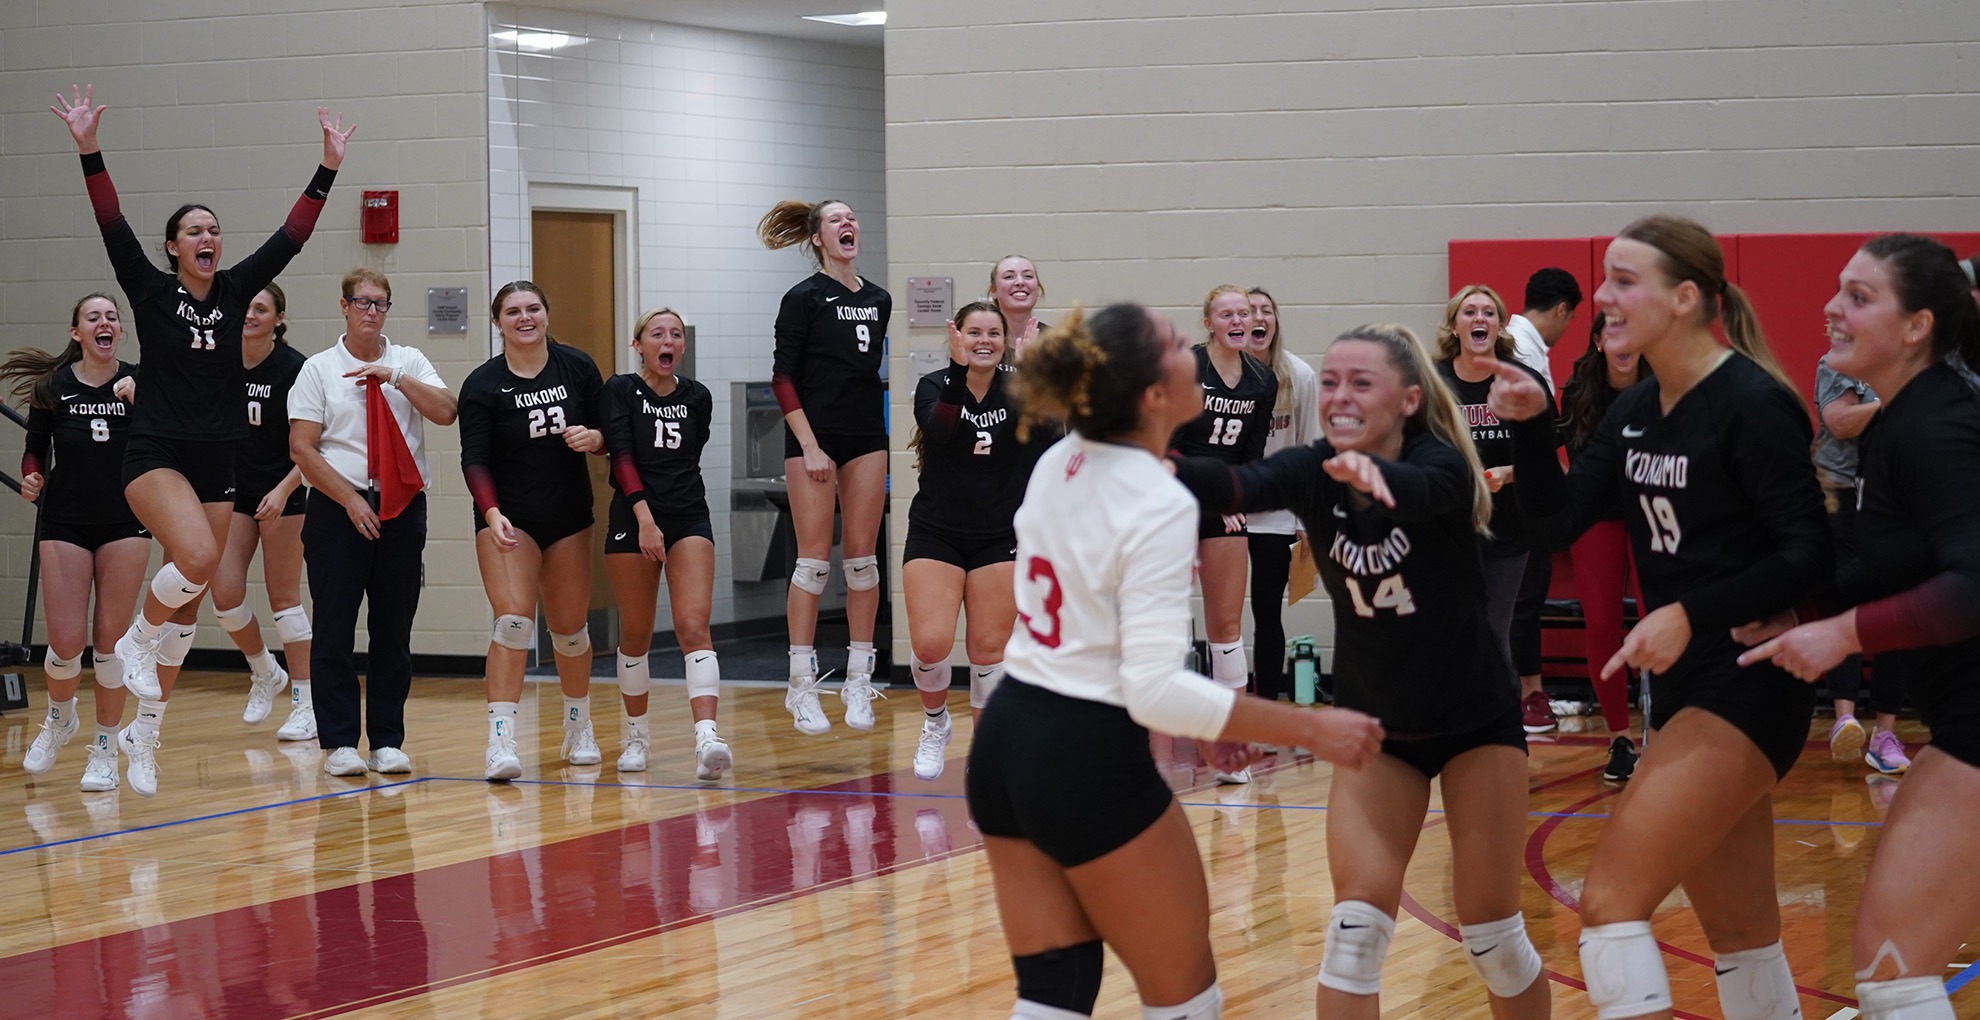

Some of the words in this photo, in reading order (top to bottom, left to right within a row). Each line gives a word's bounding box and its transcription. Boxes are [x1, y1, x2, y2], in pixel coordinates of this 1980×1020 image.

[836, 305, 879, 321] KOKOMO
[189, 326, 216, 350] 11
[855, 324, 871, 352] 9
[69, 402, 126, 416] KOKOMO
[514, 385, 568, 409] KOKOMO
[642, 399, 688, 419] KKOMO
[1204, 394, 1255, 415] KOKOMO
[90, 418, 110, 442] 8
[528, 405, 567, 439] 23
[654, 418, 682, 449] 15
[1208, 417, 1243, 446] 18
[1471, 428, 1511, 440] EYBAL
[972, 430, 992, 455] 2
[1624, 448, 1689, 489] KOKOMO
[1639, 493, 1682, 555] 19
[1328, 526, 1412, 576] KOKOMO
[1345, 573, 1417, 618] 14
